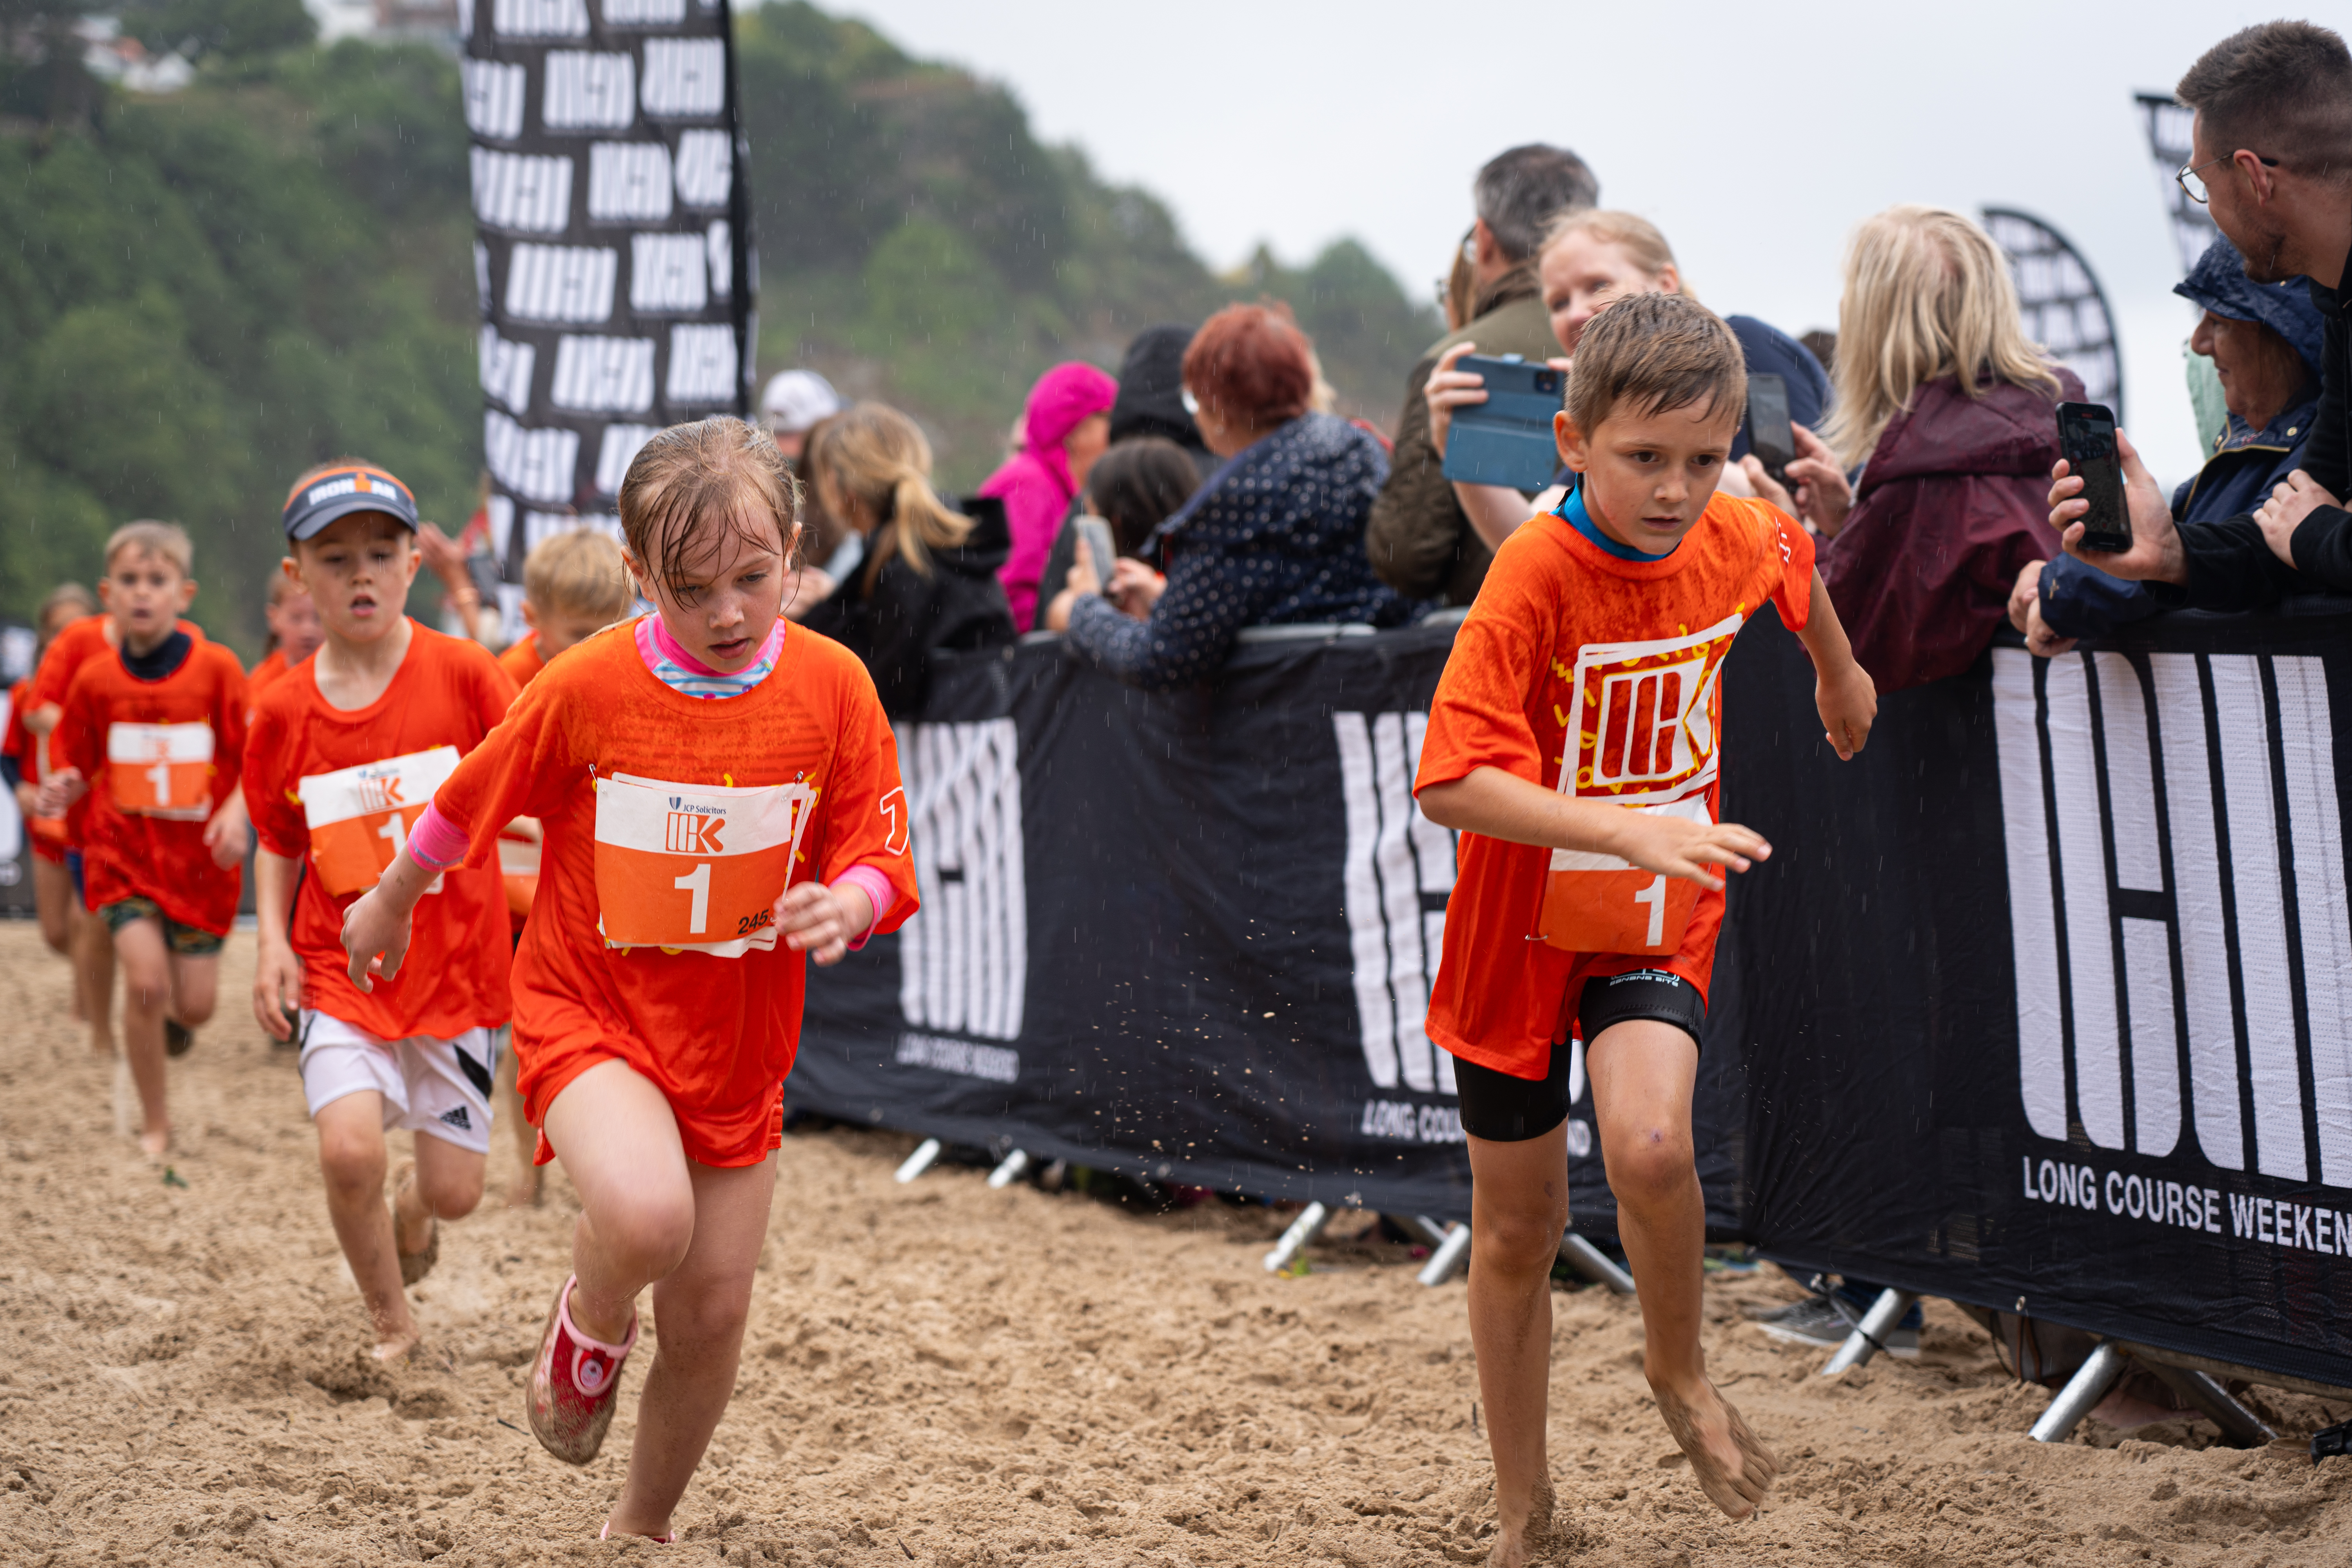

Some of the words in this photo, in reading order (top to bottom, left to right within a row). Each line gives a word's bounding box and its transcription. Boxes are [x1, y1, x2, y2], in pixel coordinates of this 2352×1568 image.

[145, 762, 171, 807] 1
[683, 804, 695, 813] JCP
[695, 805, 727, 815] Solicitors
[377, 812, 408, 858] 1
[675, 863, 711, 934] 1
[1634, 874, 1666, 947] 1
[738, 908, 769, 935] 245
[1360, 1099, 1416, 1136] LONG
[2023, 1156, 2097, 1210] LONG
[2105, 1171, 2221, 1234] COURSE
[2229, 1192, 2352, 1257] WEEKEN
